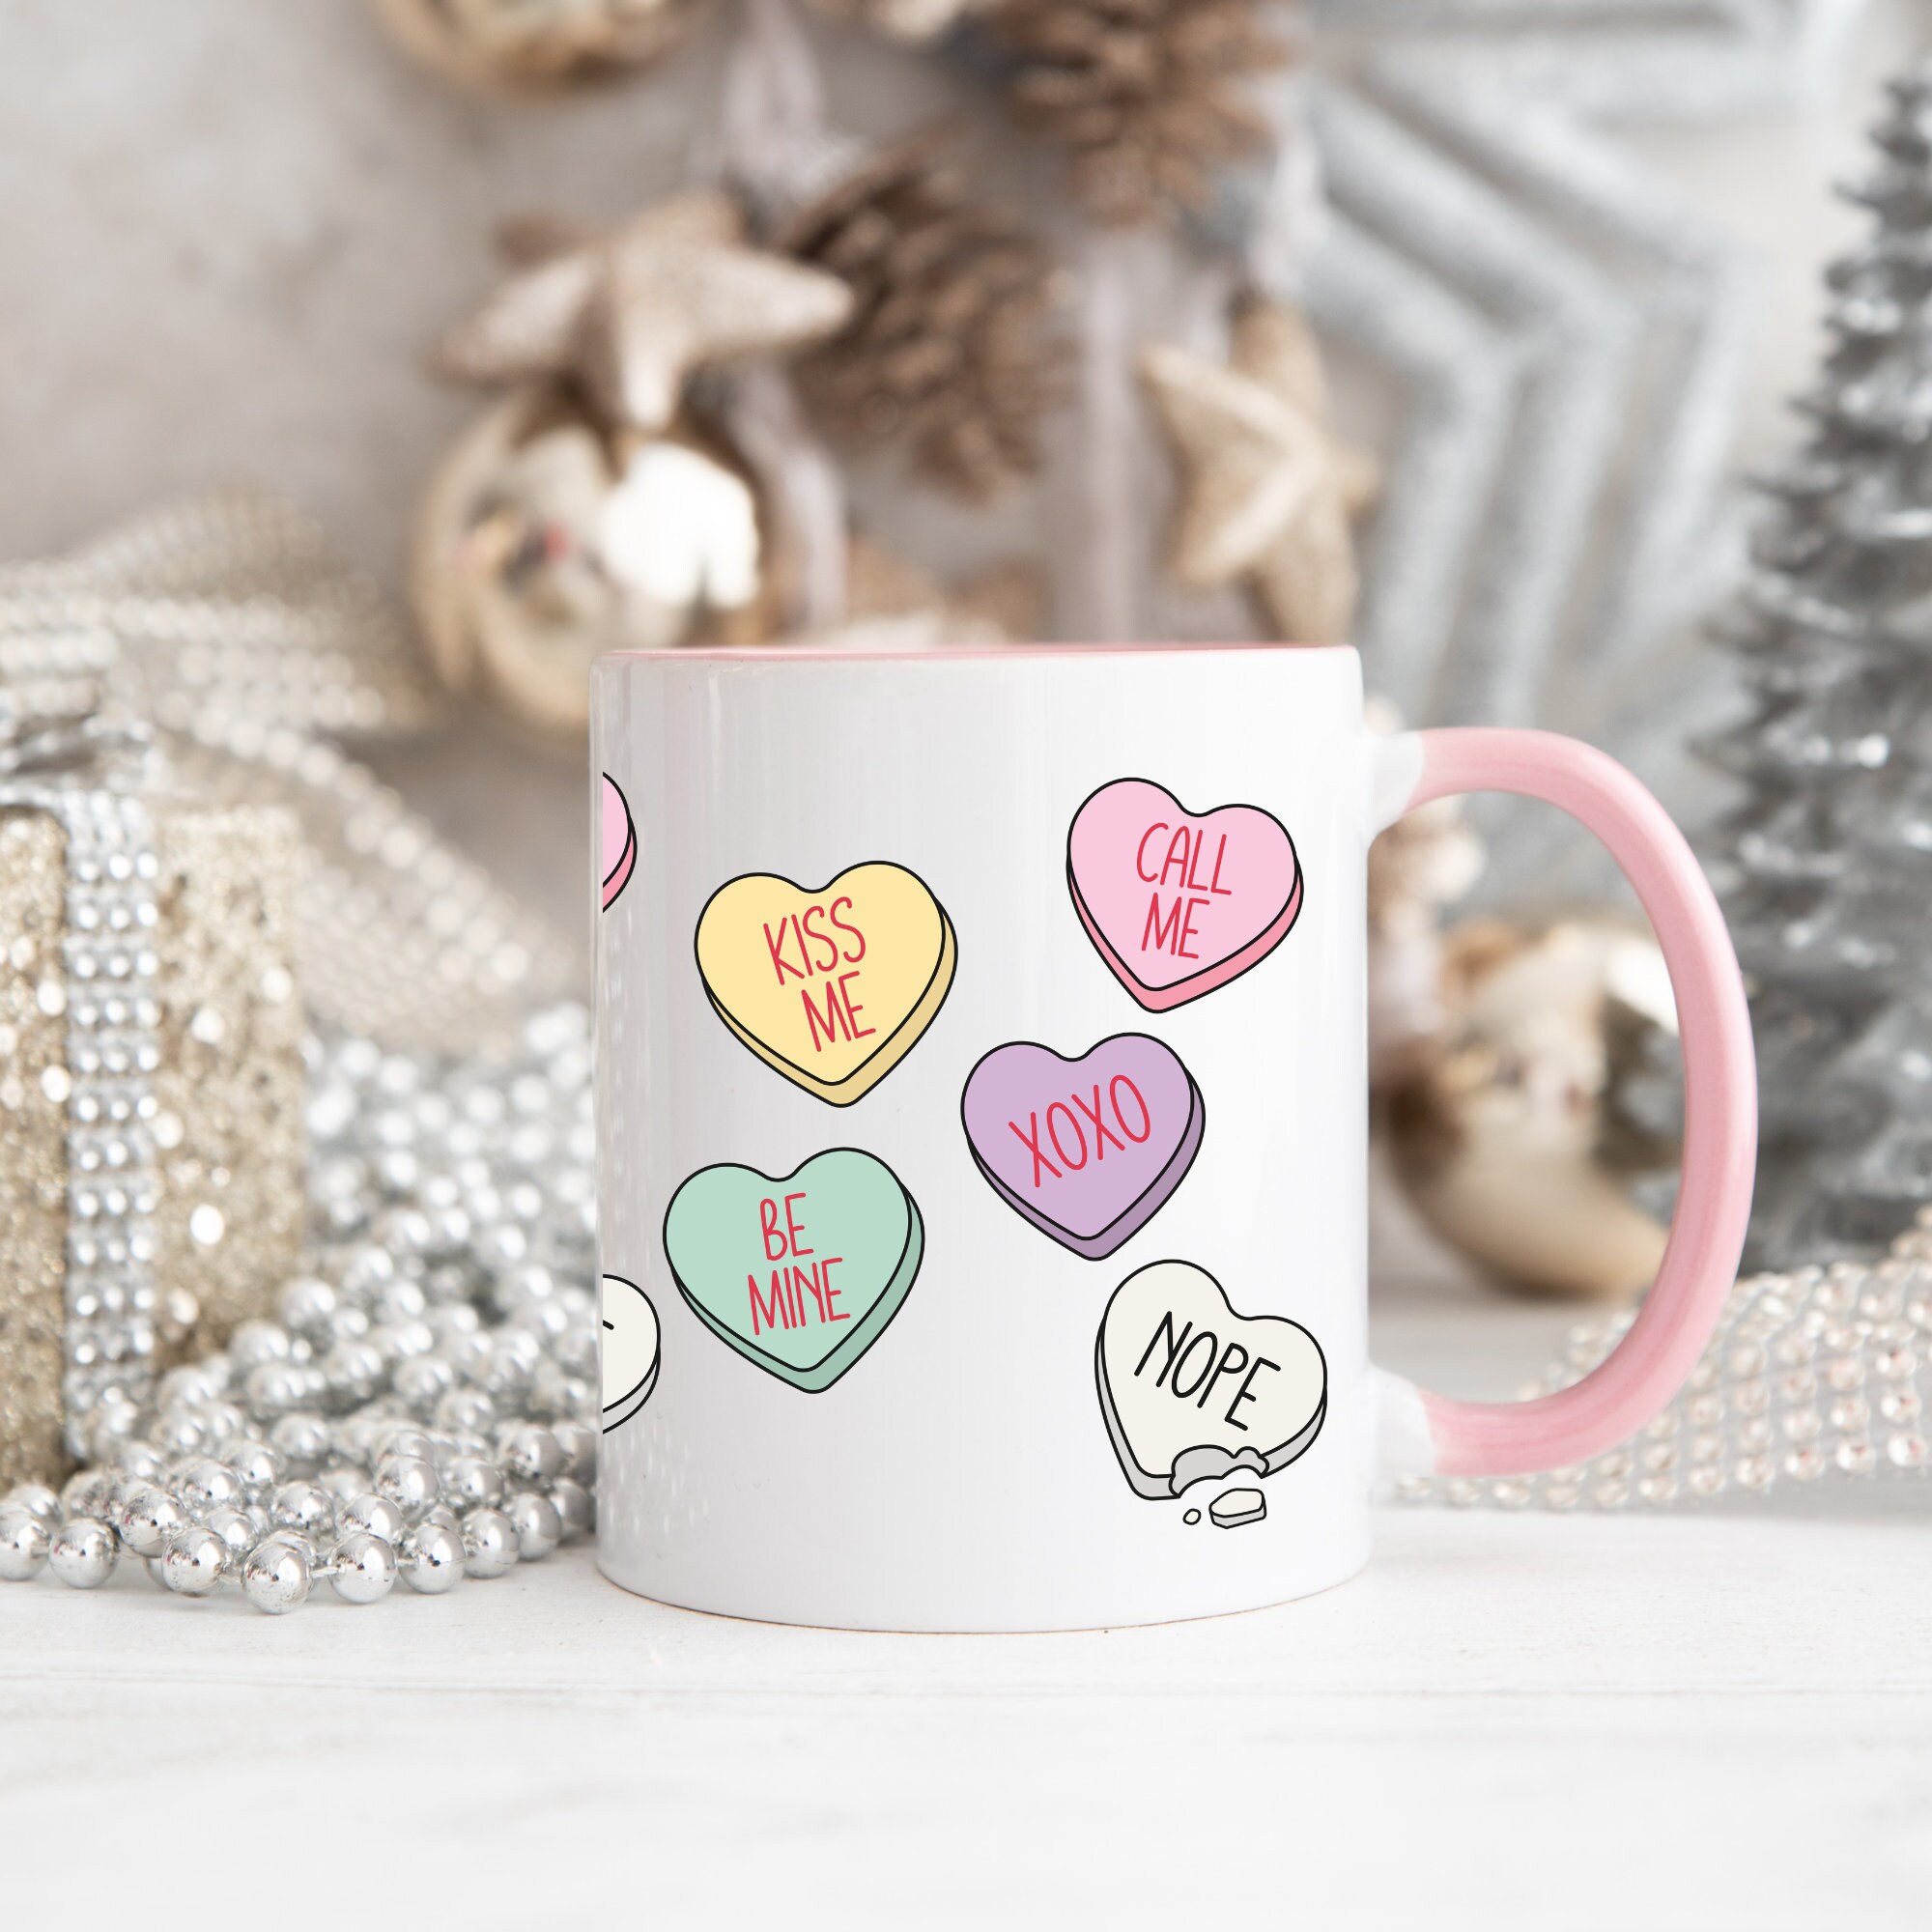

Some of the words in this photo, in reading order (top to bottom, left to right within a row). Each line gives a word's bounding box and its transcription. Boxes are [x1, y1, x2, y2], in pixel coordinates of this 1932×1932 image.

[1136, 822, 1233, 895] CALL
[762, 896, 867, 986] KISS
[1141, 892, 1210, 959] ME
[801, 971, 876, 1052] ME
[1008, 1074, 1151, 1188] XOXO
[759, 1192, 814, 1261] BE
[748, 1257, 851, 1336] MINE
[1133, 1311, 1281, 1432] NOPE
